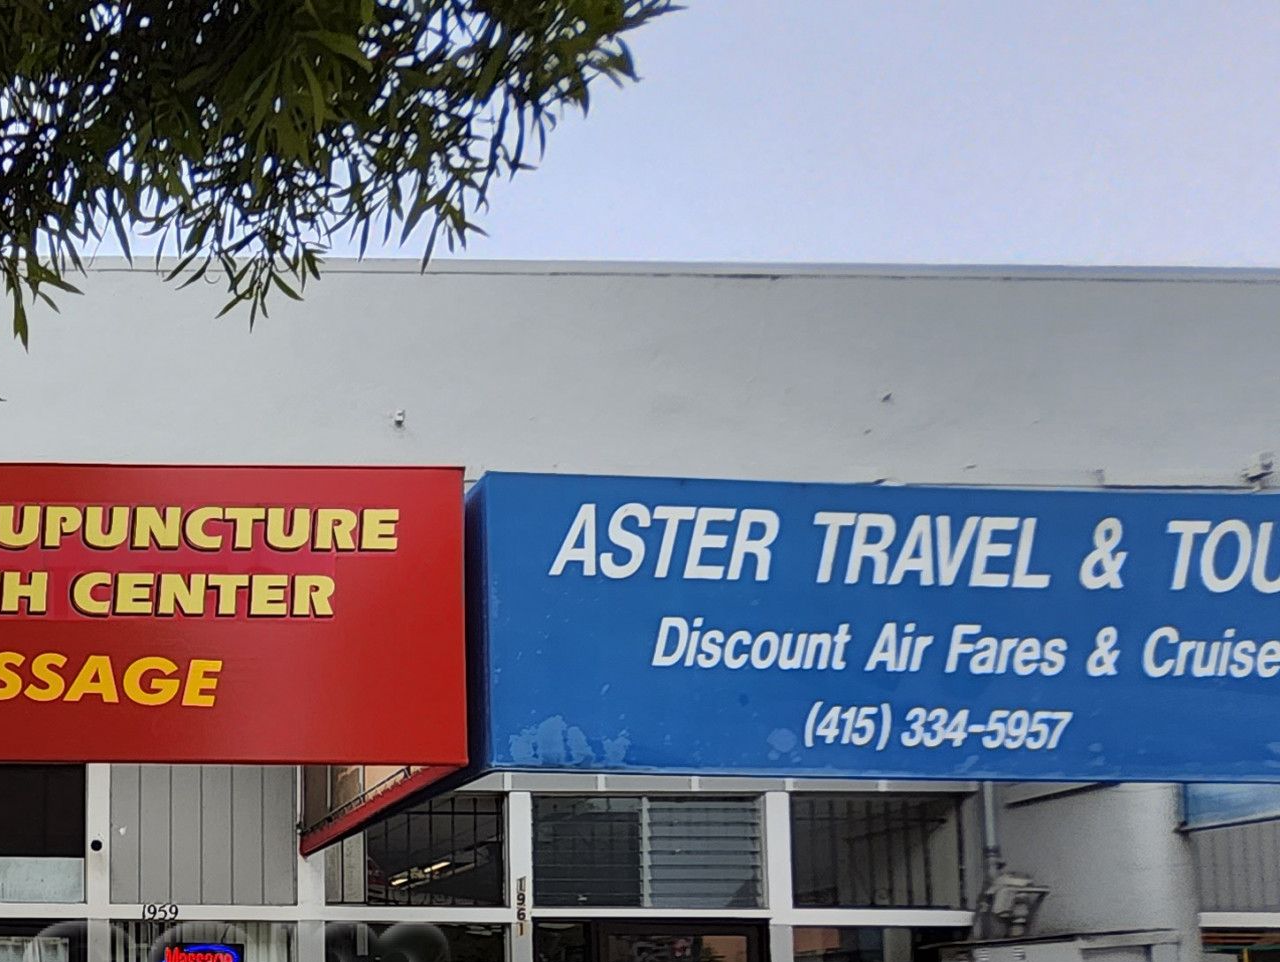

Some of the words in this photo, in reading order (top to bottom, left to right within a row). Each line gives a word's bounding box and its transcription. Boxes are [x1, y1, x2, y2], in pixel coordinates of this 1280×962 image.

[549, 503, 780, 580] ASTER
[813, 511, 1053, 589] TRAVEL
[1079, 517, 1128, 590] &
[1166, 519, 1280, 594] TOU
[70, 571, 336, 618] CENTER
[651, 615, 852, 670] Discount
[864, 621, 933, 673] Air
[944, 623, 1066, 677] Fares
[1086, 626, 1120, 677] &
[1143, 626, 1280, 678] Cruise
[803, 701, 892, 751] (415)
[900, 707, 1073, 750] 334-5957
[142, 904, 179, 921] 1959
